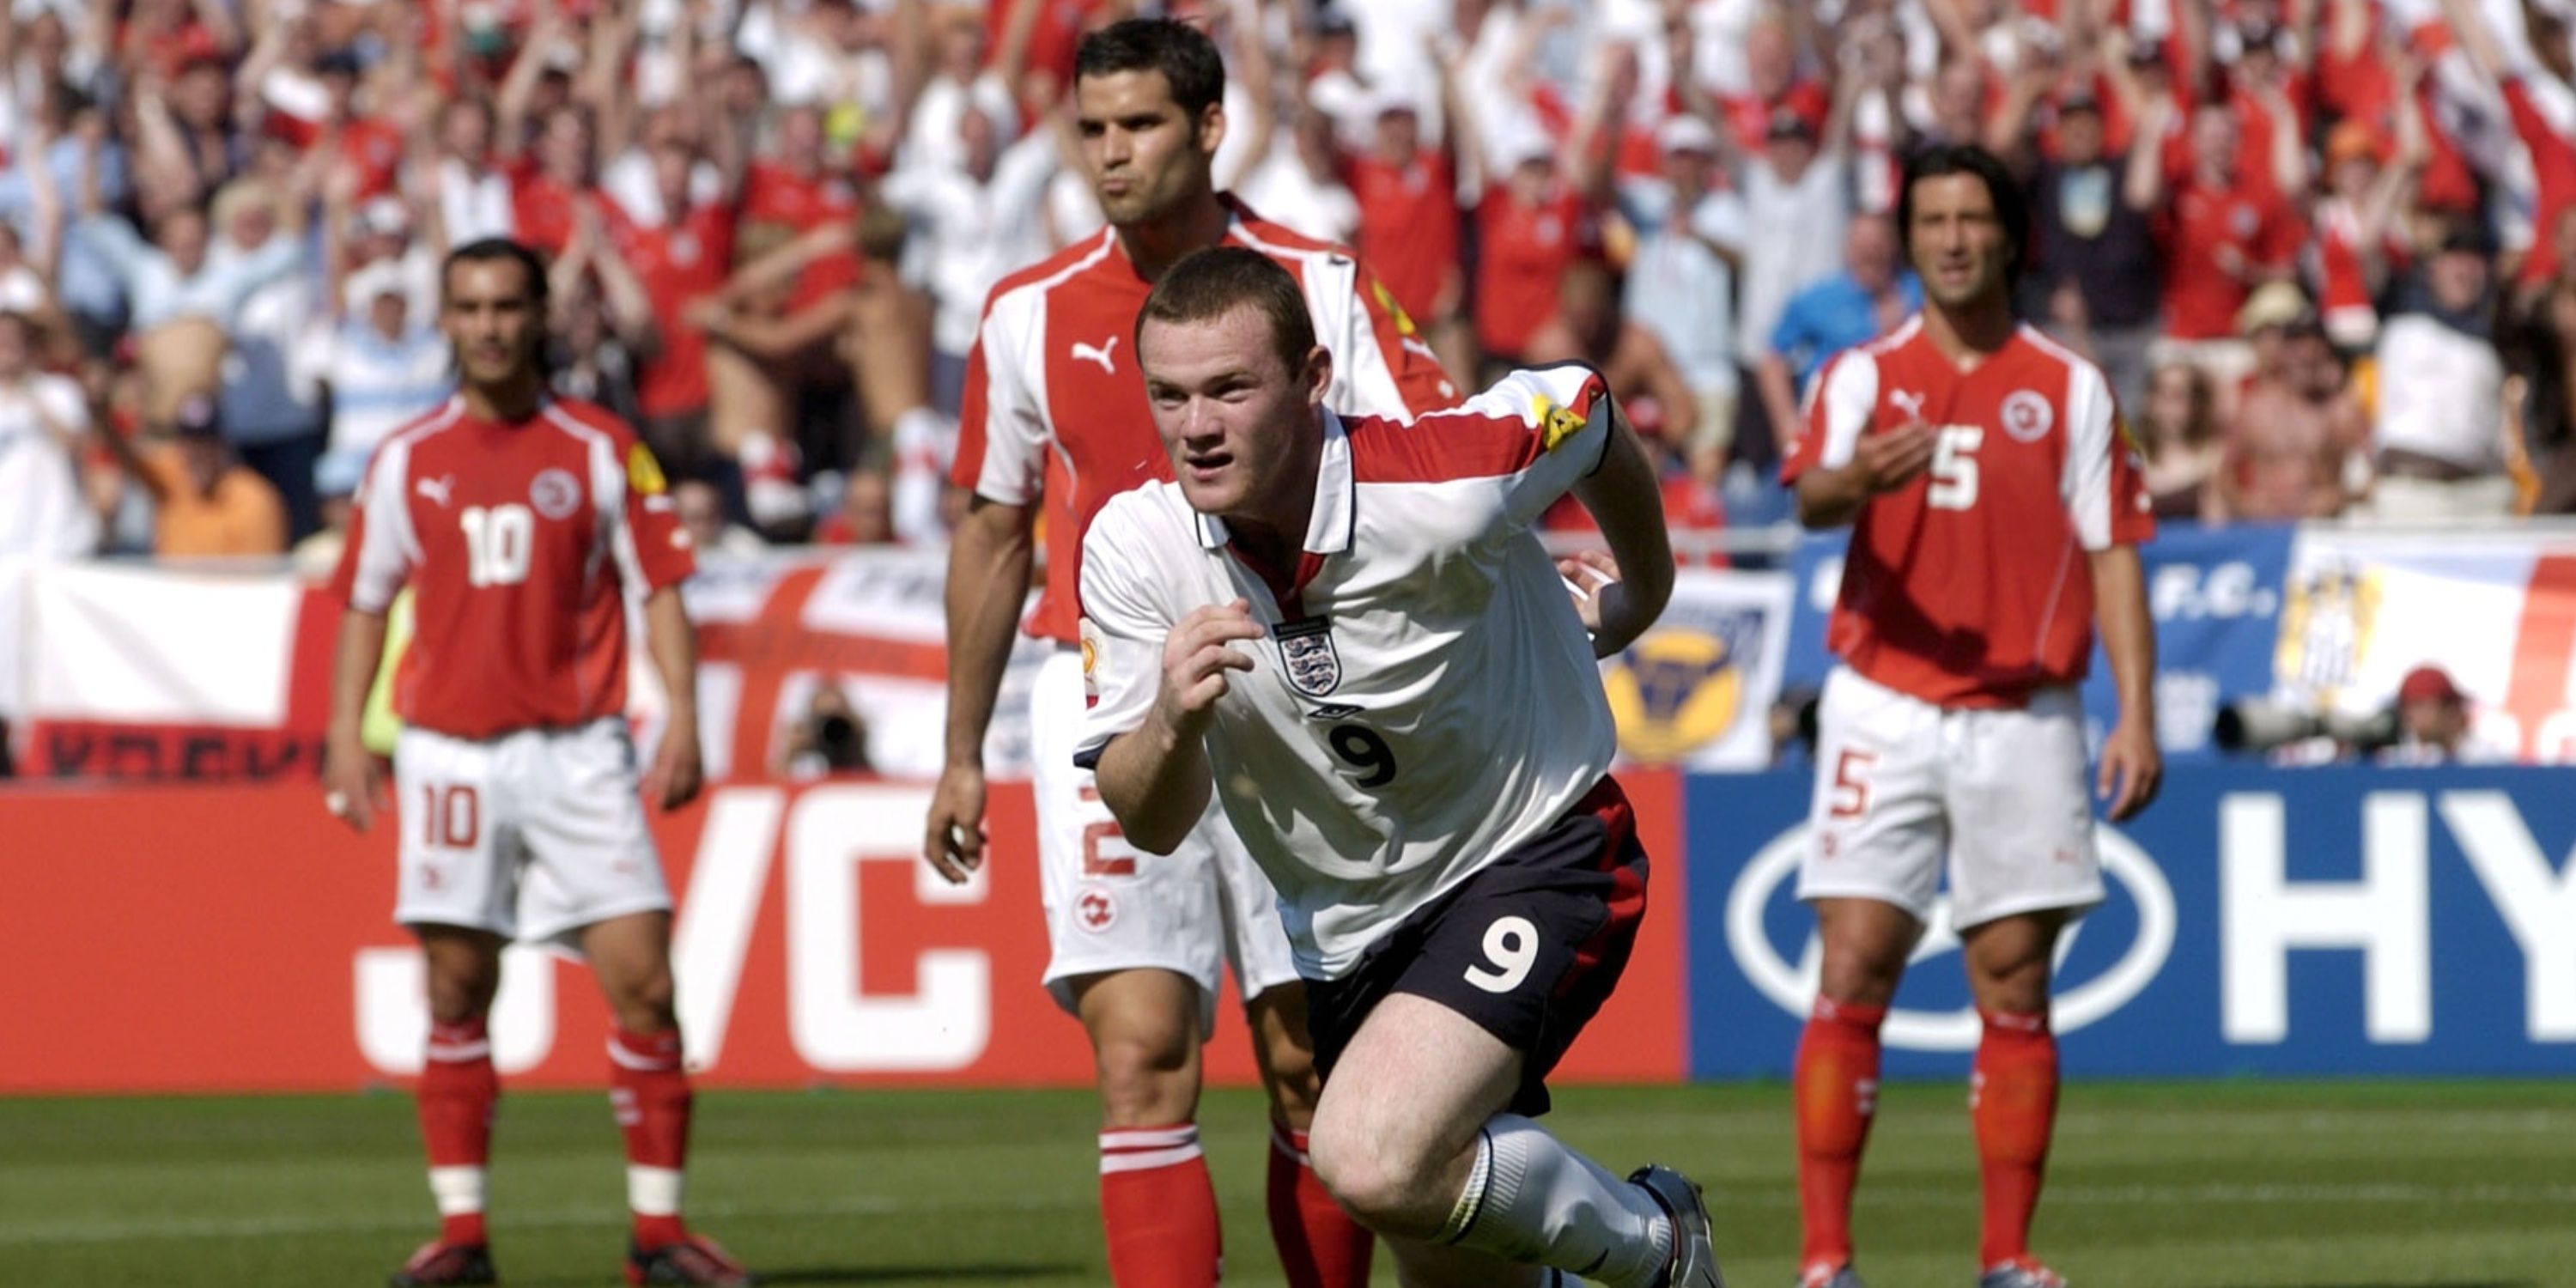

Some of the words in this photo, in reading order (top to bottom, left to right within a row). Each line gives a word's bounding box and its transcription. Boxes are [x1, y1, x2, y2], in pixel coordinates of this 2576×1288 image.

[1927, 425, 1984, 512] 5
[459, 503, 534, 587] 10
[1328, 723, 1397, 789] 9
[1830, 744, 1877, 819] 5
[422, 782, 478, 848] 10
[1462, 914, 1540, 993] 9
[2219, 791, 2576, 1043] HY
